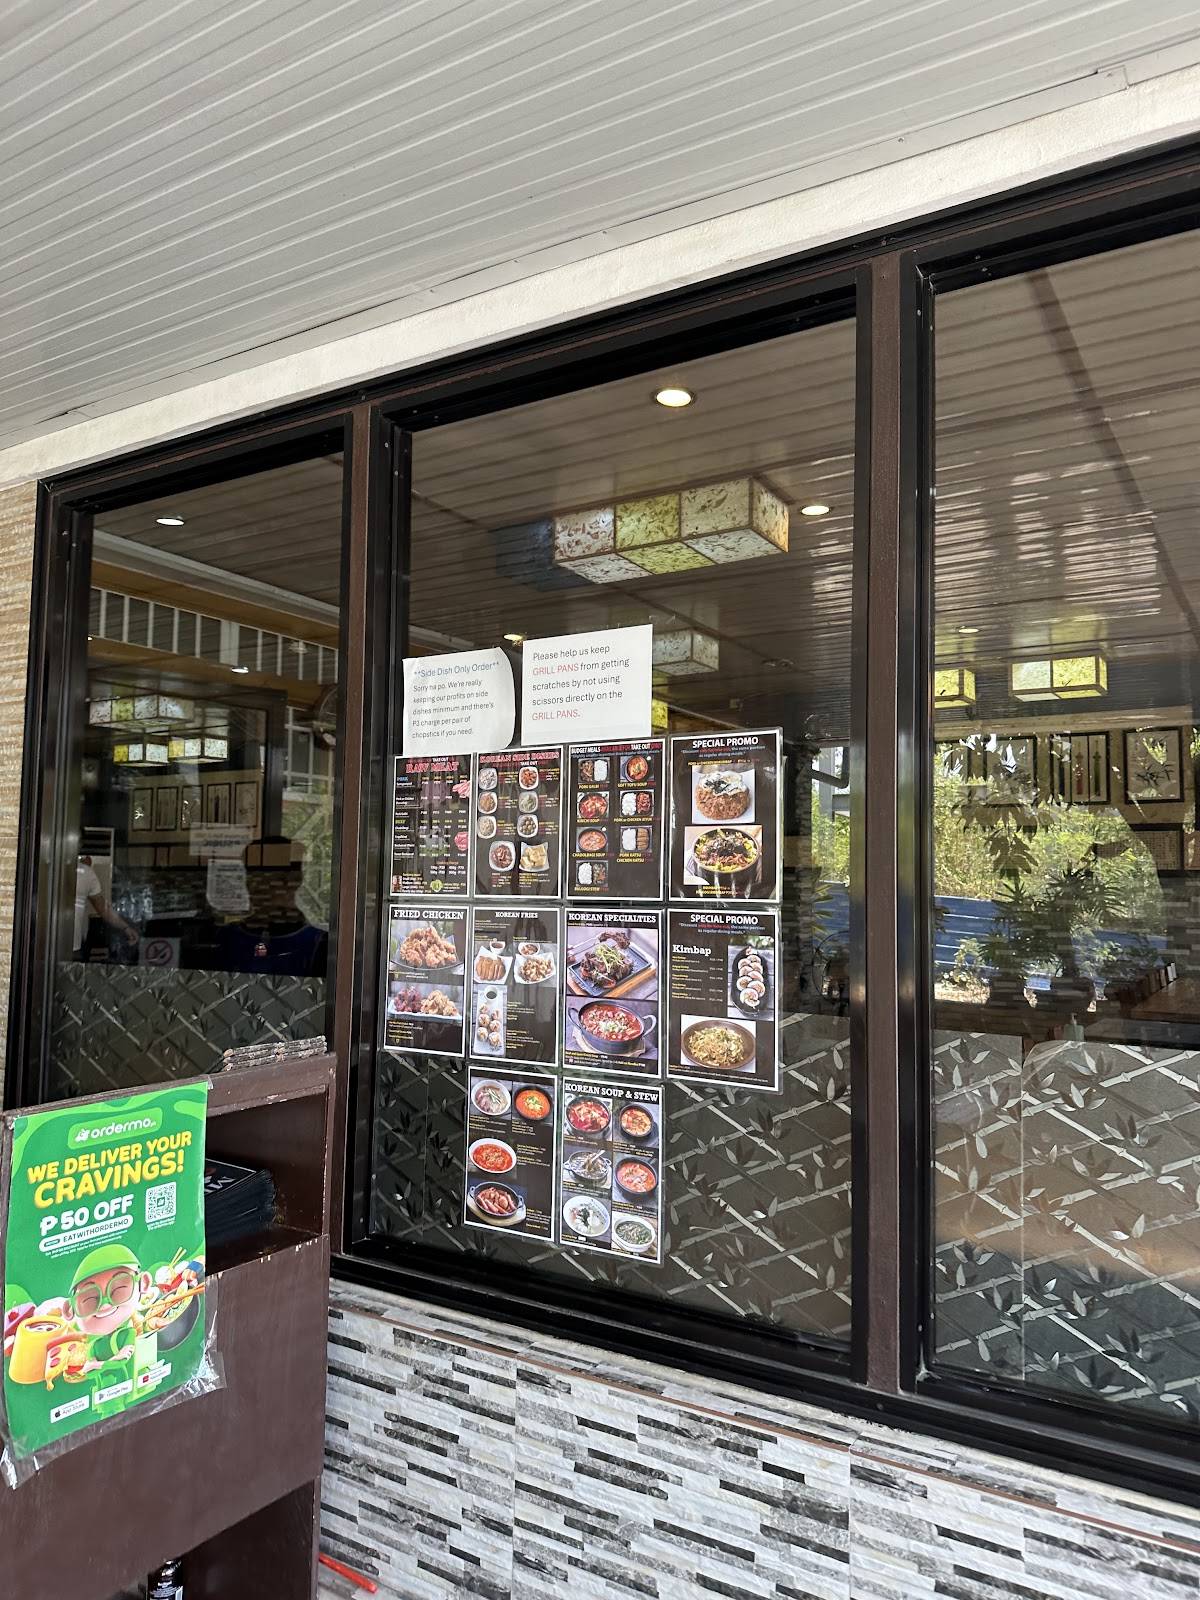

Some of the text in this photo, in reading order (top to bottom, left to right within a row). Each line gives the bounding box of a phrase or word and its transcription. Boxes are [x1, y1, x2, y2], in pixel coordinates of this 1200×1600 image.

[533, 645, 610, 661] Please help us keep
[437, 667, 453, 676] Dish
[454, 665, 470, 674] Only
[532, 659, 630, 676] GRILL PANS from getting
[413, 685, 429, 693] Sorry
[448, 680, 465, 688] We're
[466, 679, 482, 687] really
[532, 675, 620, 691] scratches by not using
[446, 692, 466, 701] profits
[475, 690, 489, 698] side
[532, 696, 564, 706] scissors
[565, 692, 595, 702] directly
[609, 690, 623, 699] the
[412, 707, 432, 715] dishes
[460, 703, 473, 711] and
[532, 709, 581, 721] GRILL PANS.
[420, 718, 440, 727] charge
[445, 730, 457, 738] you
[692, 740, 726, 749] SPECIAL
[726, 736, 759, 747] PROMO
[393, 909, 464, 920] FRIED CHICKEN
[568, 913, 657, 923] KOREAN SPECIALTIES
[690, 914, 758, 925] SPECIAL PROMO
[672, 944, 712, 957] Kimbap
[564, 1083, 659, 1102] KOREAN SOUP & STEW
[27, 1131, 192, 1185] WE DELIVER YOUR
[33, 1149, 185, 1209] CRAVINGS!
[93, 1194, 134, 1220] OFF
[63, 1218, 129, 1243] EATWITHORDERMO
